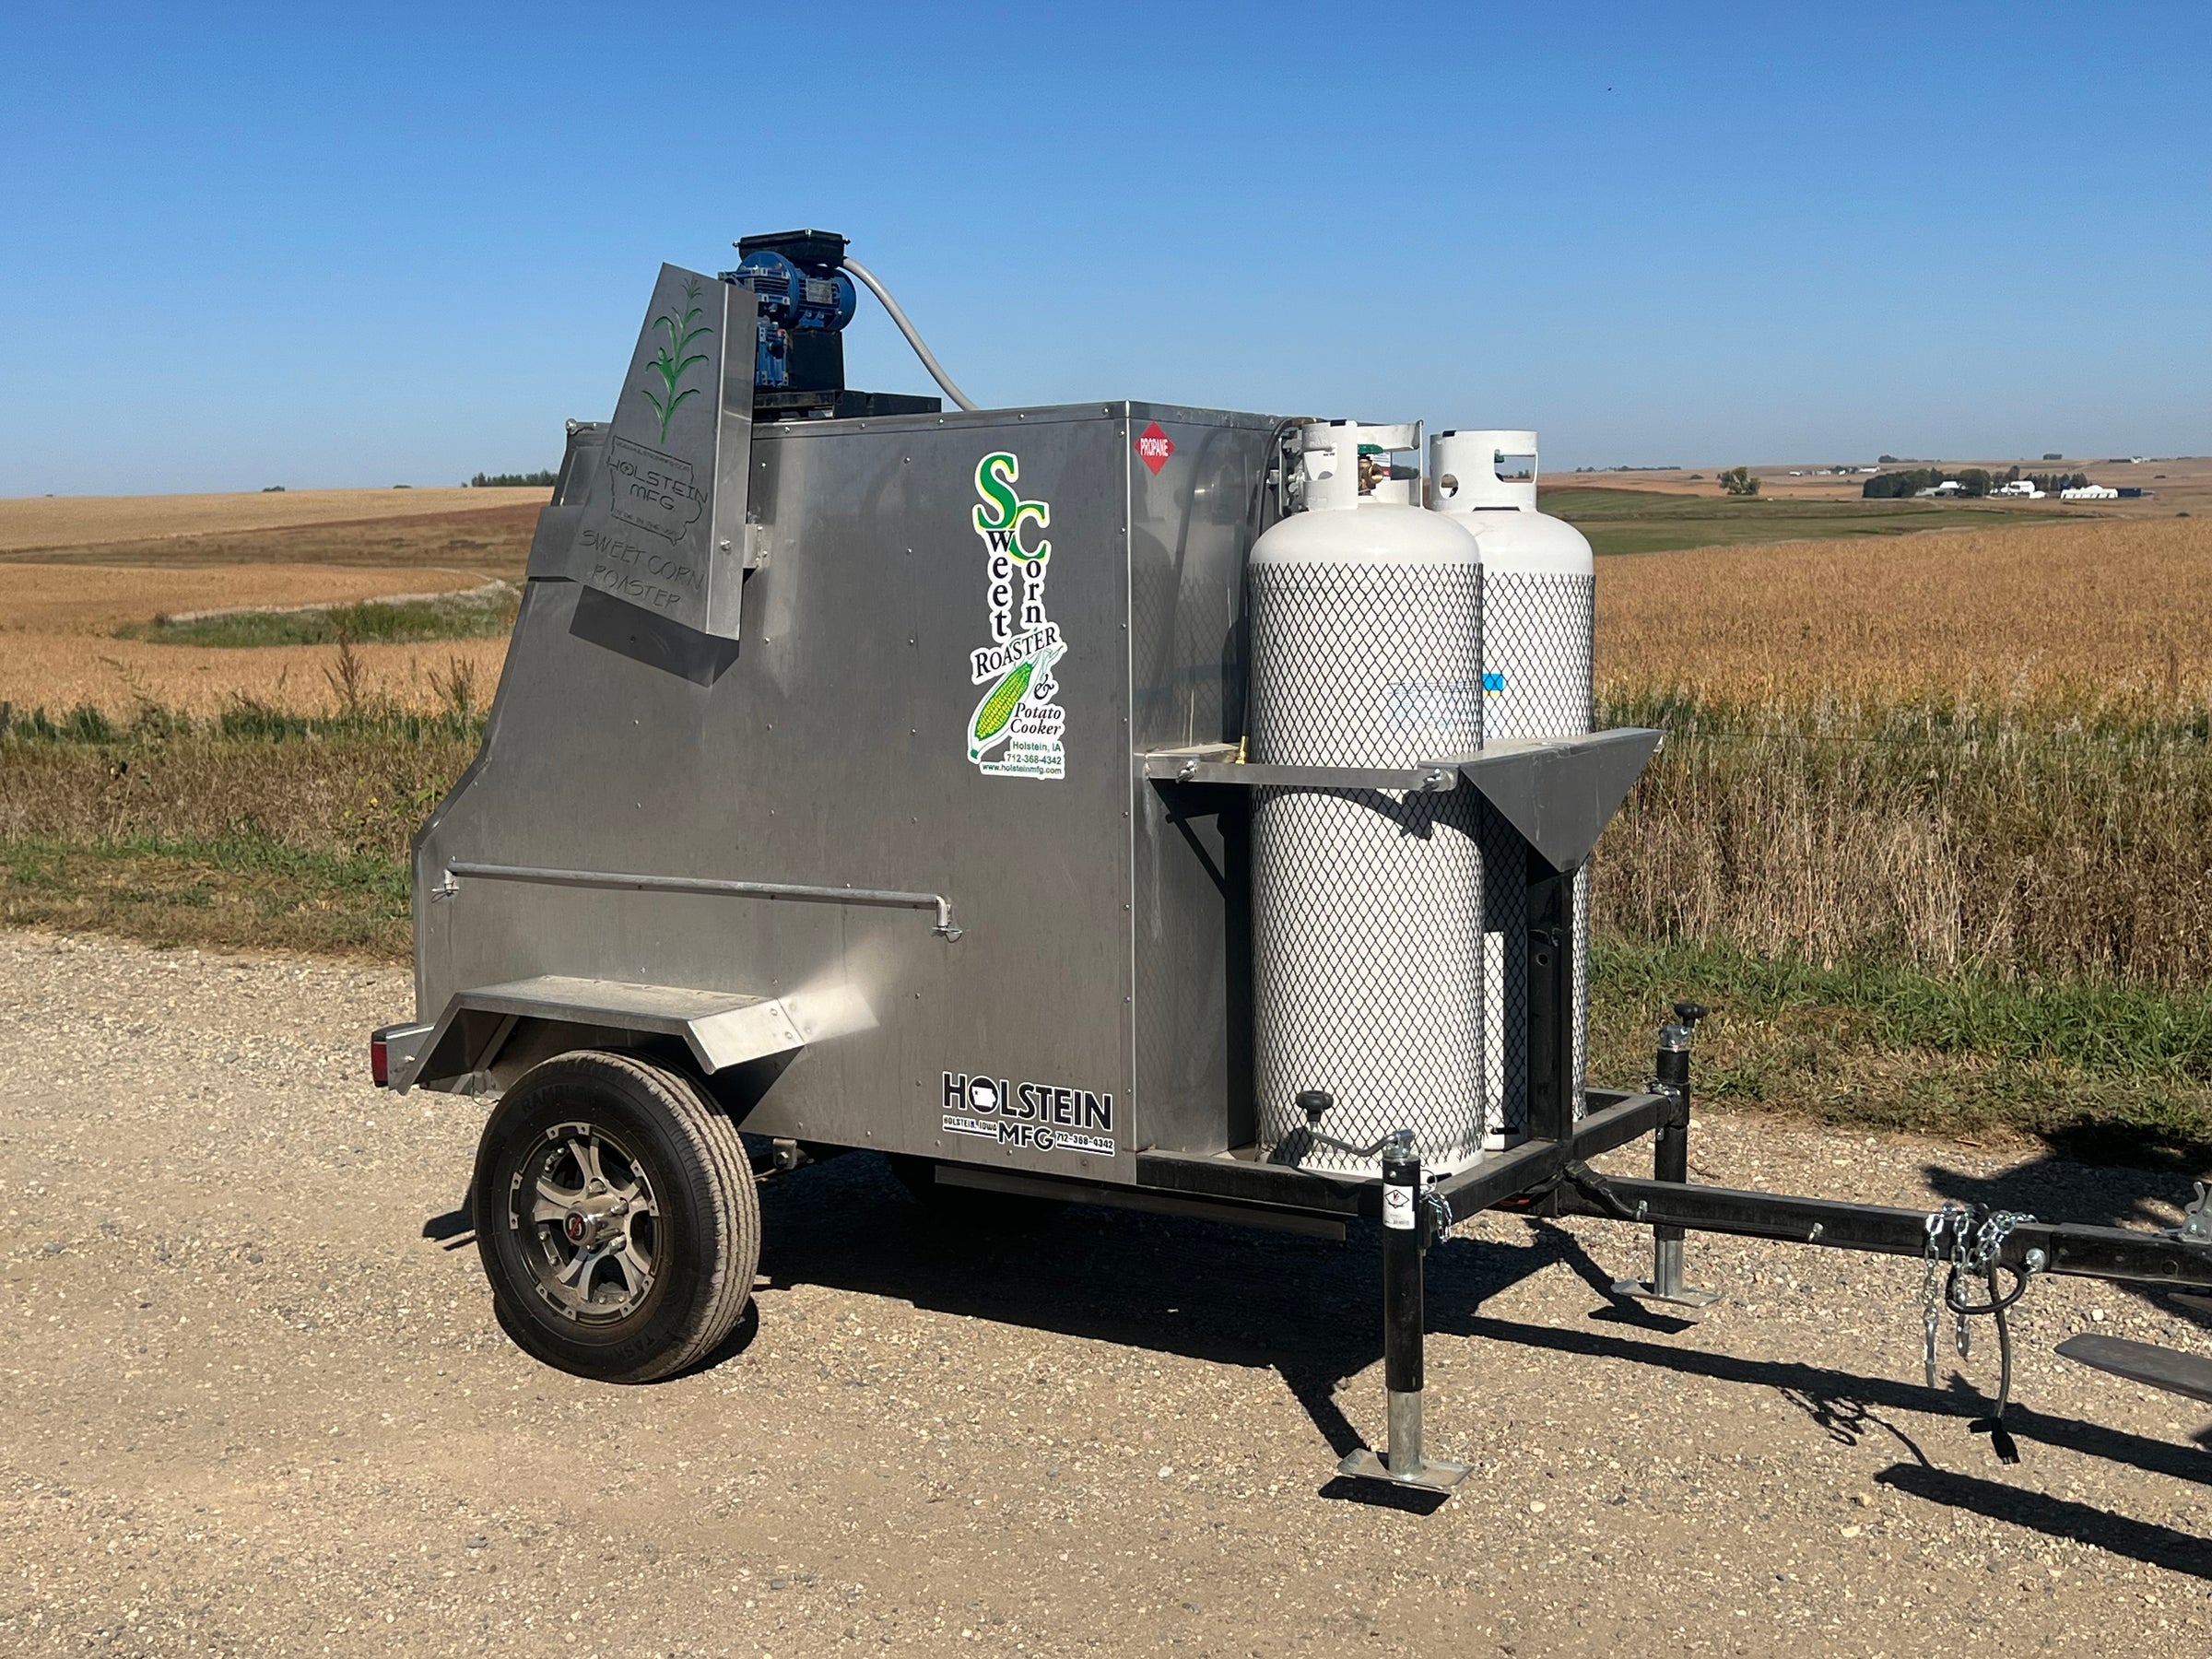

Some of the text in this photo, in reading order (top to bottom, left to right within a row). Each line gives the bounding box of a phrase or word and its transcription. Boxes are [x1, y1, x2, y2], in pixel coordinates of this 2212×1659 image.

[1140, 438, 1169, 456] PROPANE
[606, 455, 709, 503] HOLSTEIN
[975, 453, 1018, 637] Sweet
[579, 530, 704, 590] SWEET CORN
[1008, 503, 1048, 623] Corn
[591, 564, 681, 608] ROASTER
[974, 626, 1058, 678] ROASTER
[1033, 673, 1055, 700] &
[1015, 701, 1062, 720] Potato
[1010, 718, 1062, 736] Cooker
[1006, 753, 1062, 765] 712-368-4342
[1013, 740, 1062, 752] Holstein, IA
[982, 763, 1062, 775] www.holsteinmfg.com
[944, 1072, 1112, 1131] HOLSTEIN
[979, 1121, 997, 1131] IOWA
[998, 1121, 1055, 1151] MFG
[1056, 1133, 1113, 1149] 712-368-4342
